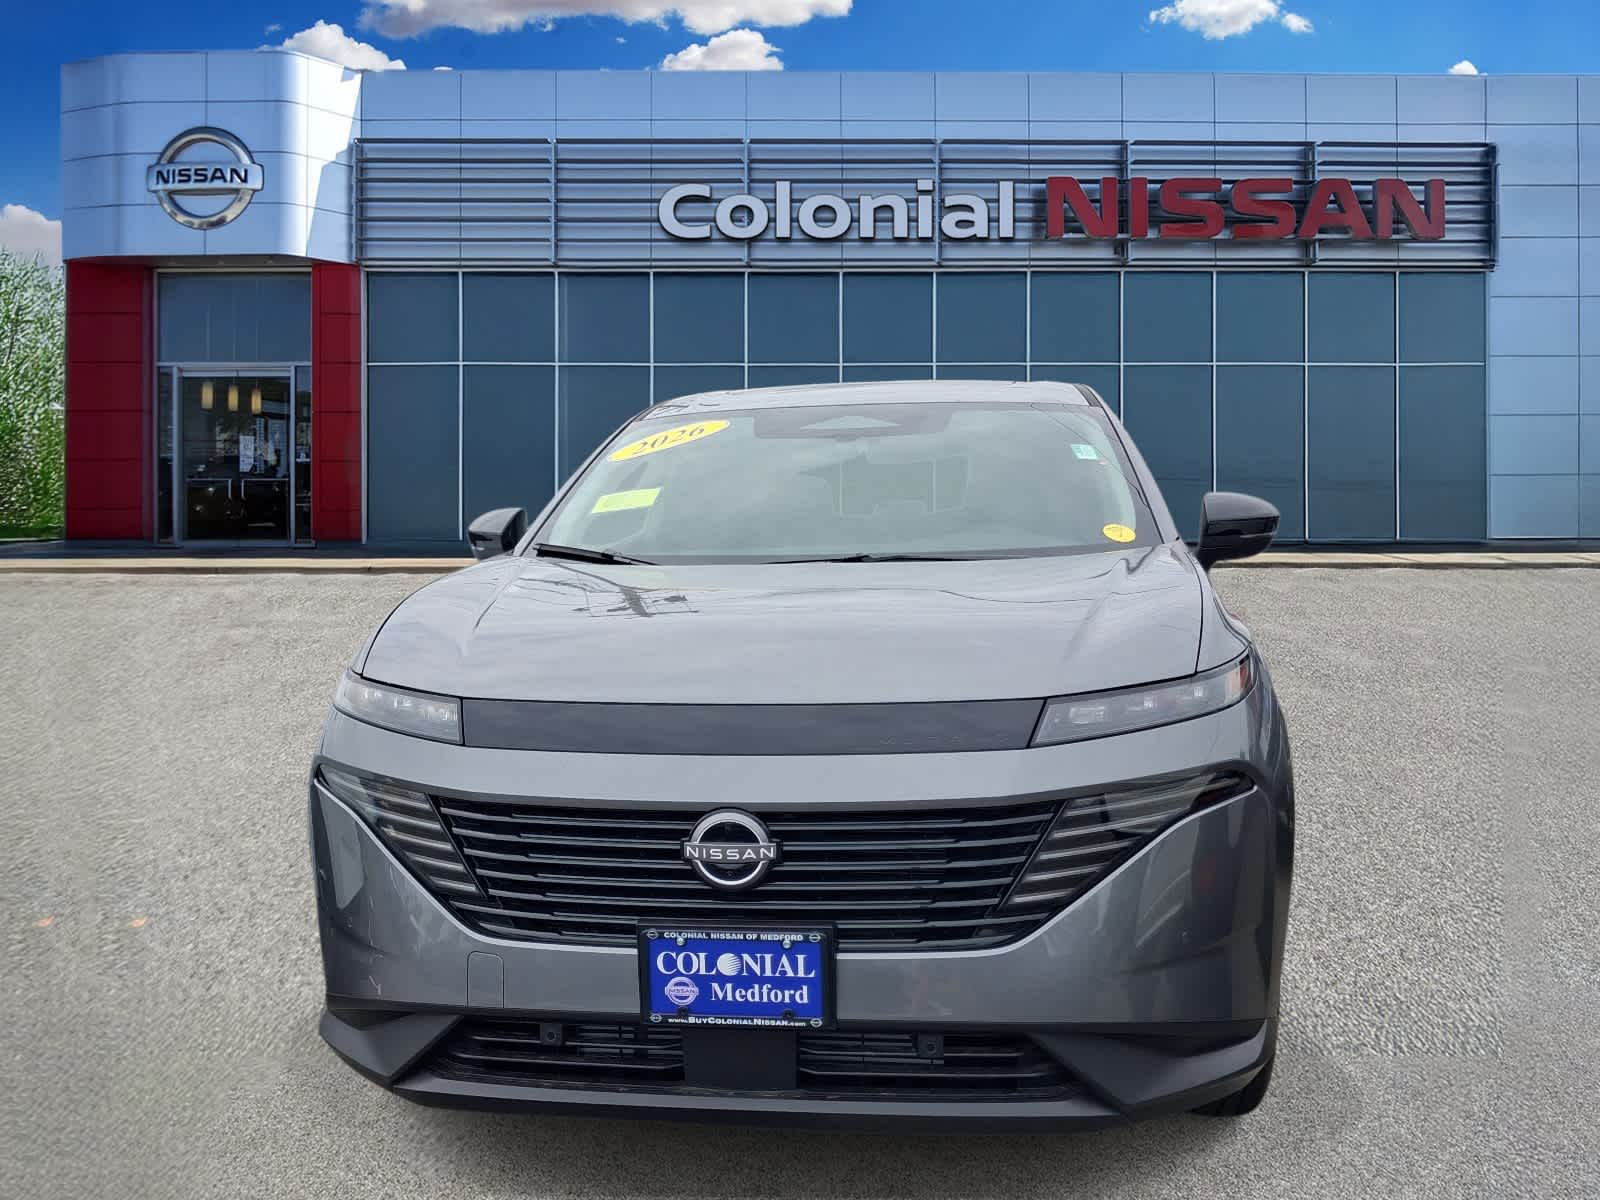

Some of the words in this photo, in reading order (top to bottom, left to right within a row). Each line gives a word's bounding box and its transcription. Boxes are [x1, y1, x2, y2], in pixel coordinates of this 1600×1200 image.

[156, 167, 248, 184] NISSAN
[658, 180, 1014, 240] Colonial
[1046, 176, 1446, 240] NISSAN
[633, 426, 705, 454] 2026
[686, 845, 774, 860] NISSAN
[663, 931, 709, 940] COLONIAL
[710, 932, 744, 940] NISSAN
[745, 933, 758, 941] OF
[760, 934, 804, 942] MEDFORD
[656, 951, 816, 978] COLONIAL
[711, 983, 808, 1004] Medford
